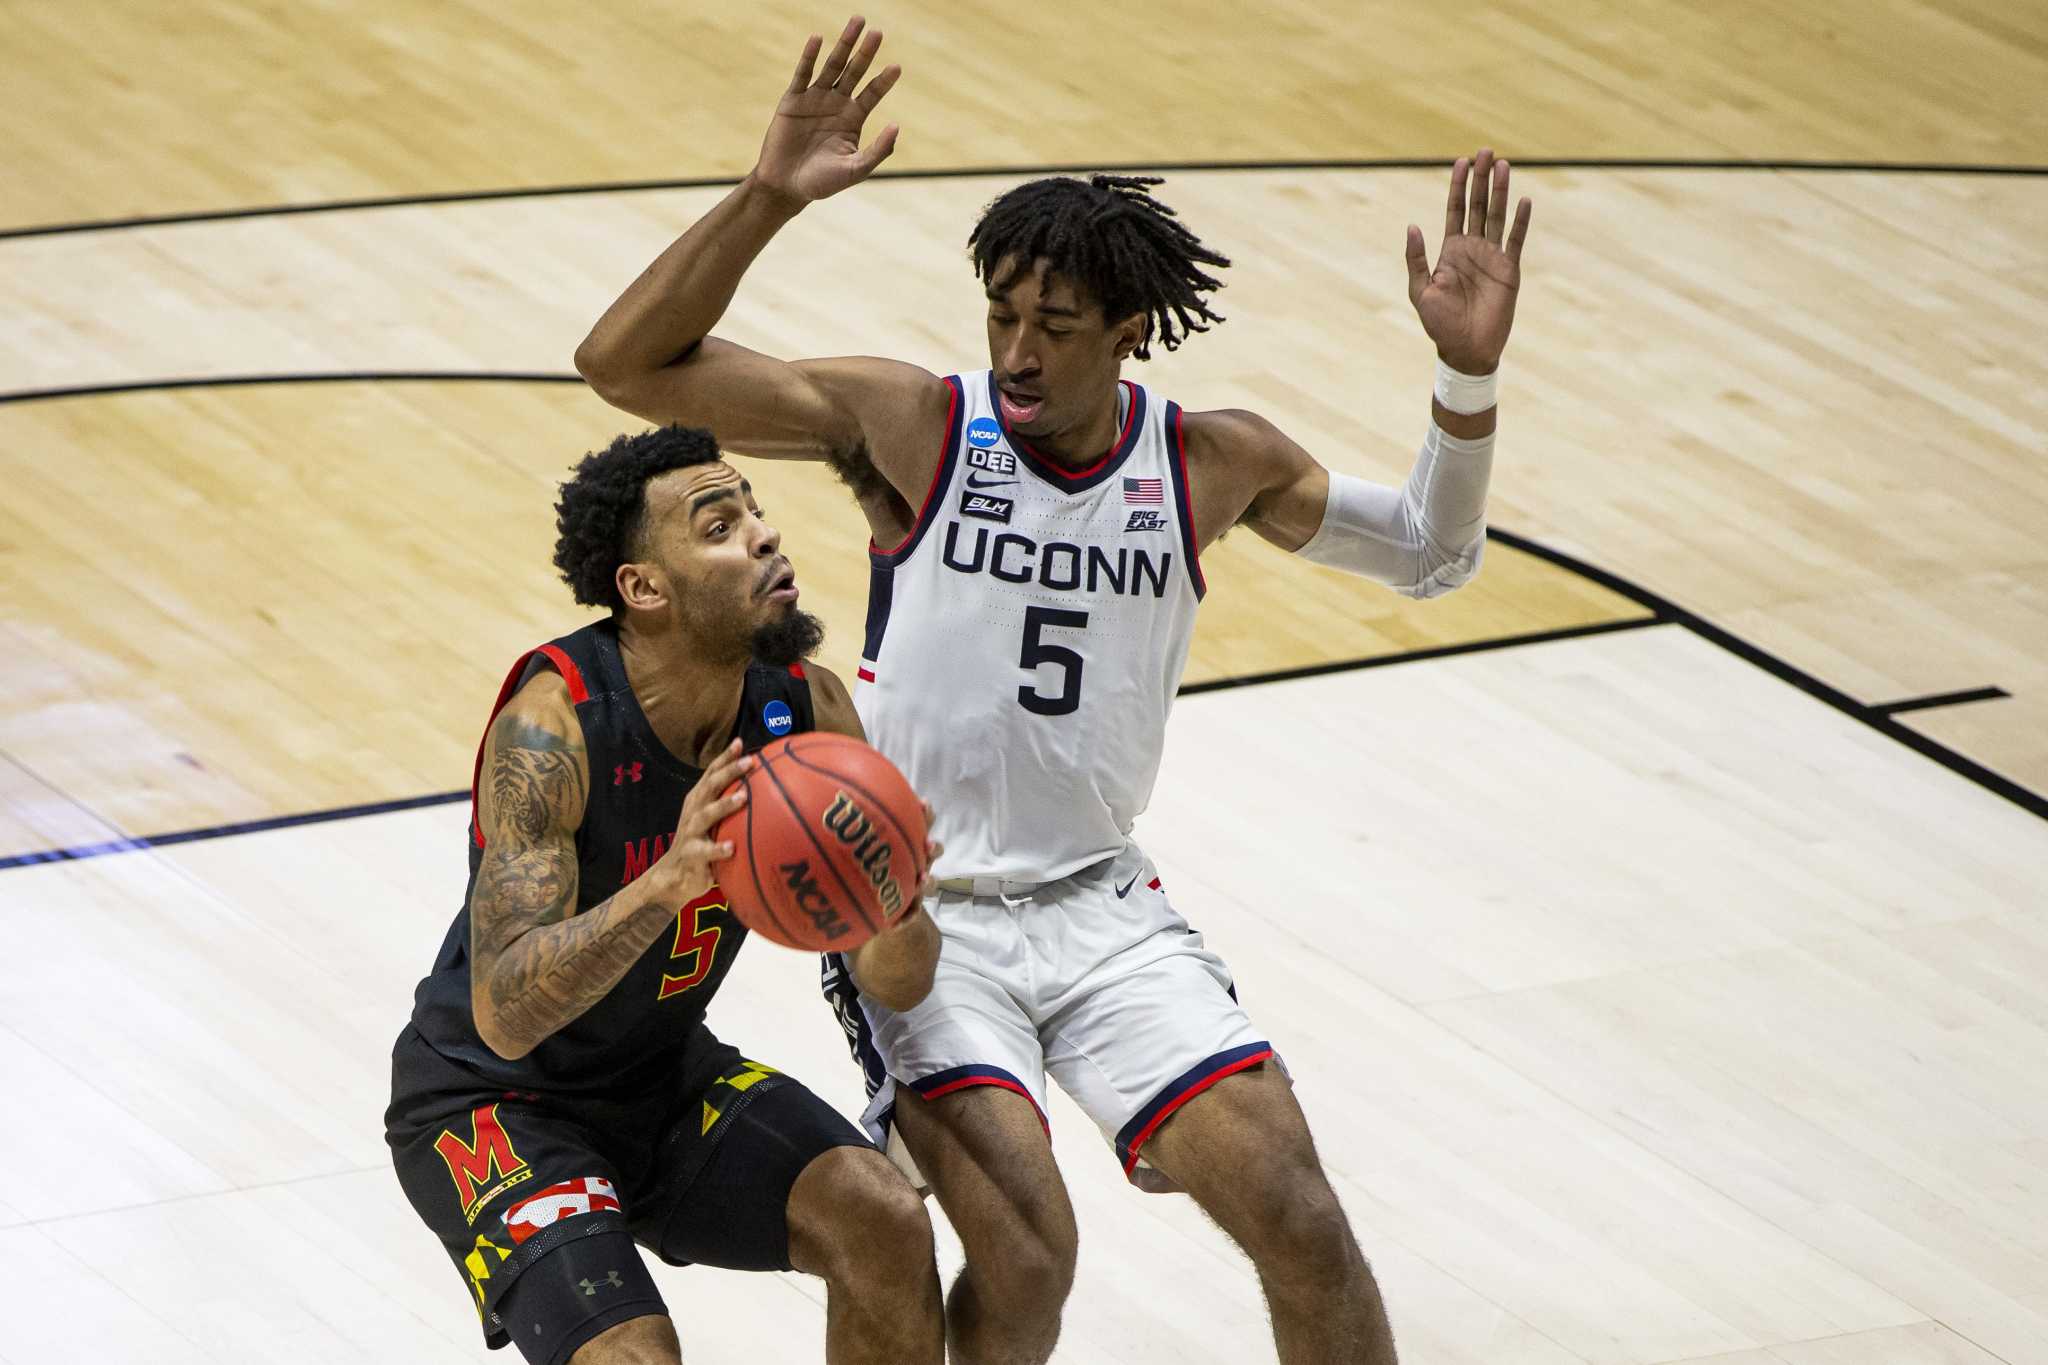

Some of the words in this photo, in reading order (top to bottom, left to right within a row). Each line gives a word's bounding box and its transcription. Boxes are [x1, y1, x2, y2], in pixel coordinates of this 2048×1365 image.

[970, 429, 998, 441] NCAA
[971, 449, 1015, 472] DEE
[967, 496, 1009, 513] BLM
[1130, 510, 1160, 520] BIG
[1125, 519, 1168, 529] EAST
[942, 520, 1171, 598] UCONN
[1017, 605, 1089, 716] 5
[768, 715, 792, 728] NCAA
[822, 789, 903, 919] Wilson
[780, 859, 851, 940] NCAA
[657, 884, 728, 1000] 5
